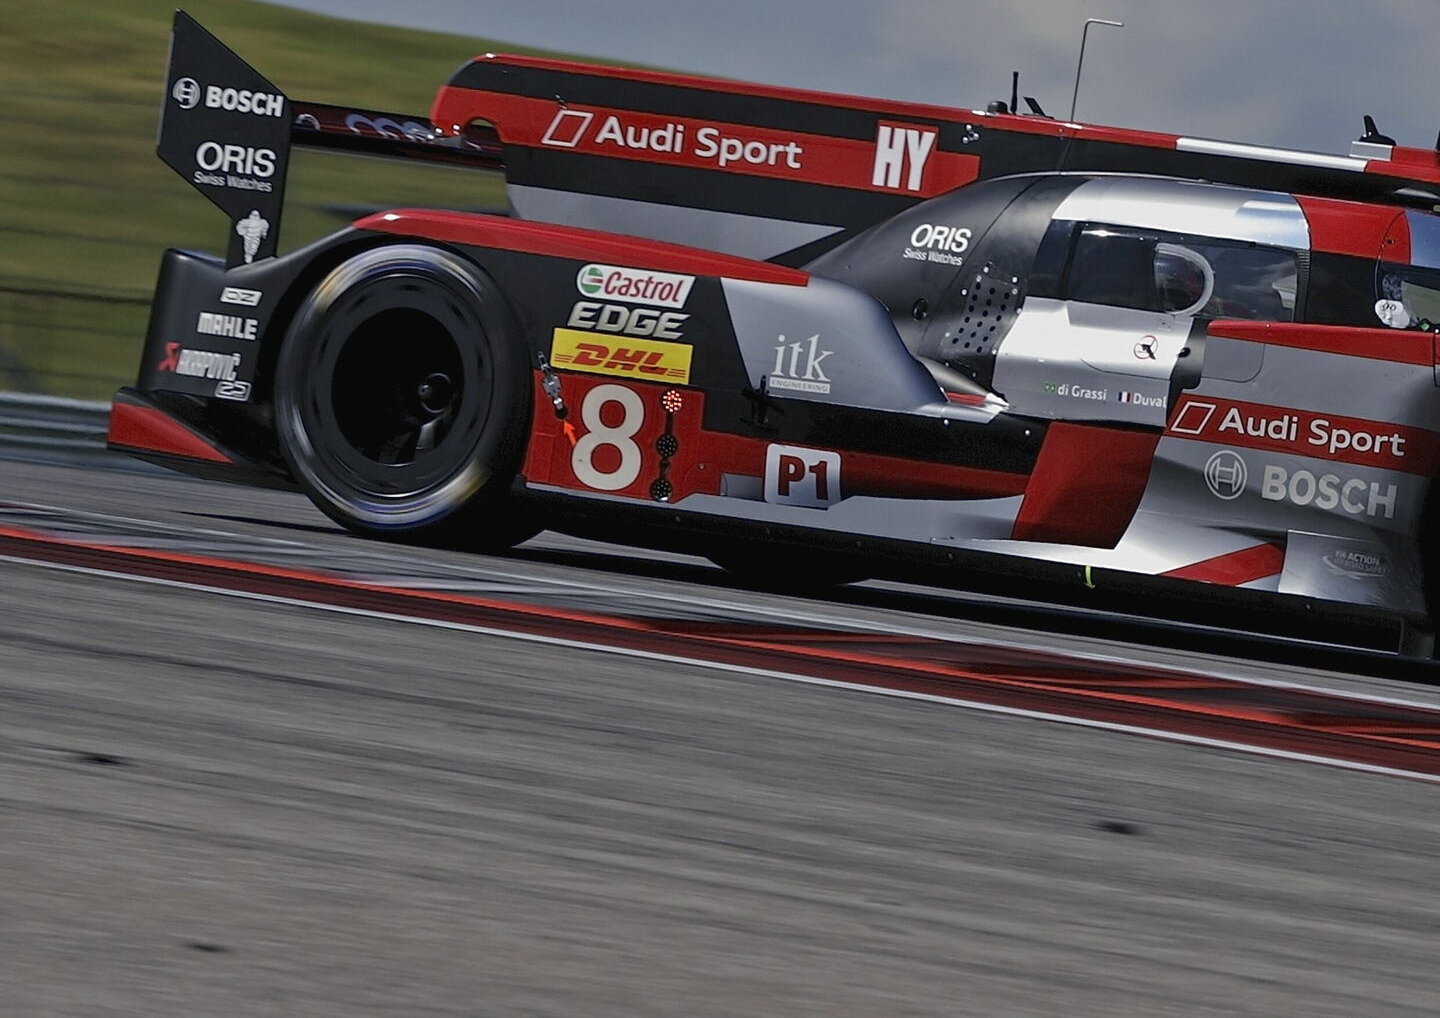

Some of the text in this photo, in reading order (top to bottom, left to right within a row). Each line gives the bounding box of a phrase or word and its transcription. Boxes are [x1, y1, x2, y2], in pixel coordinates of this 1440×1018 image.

[205, 85, 284, 117] BOSCH
[595, 115, 803, 168] Audi Sport
[196, 141, 276, 177] ORIS
[872, 125, 935, 192] HY
[193, 171, 272, 192] Swiss Watches
[910, 223, 972, 253] ORIS
[903, 247, 963, 267] Swiss Watches
[604, 270, 683, 303] Castrol
[197, 311, 258, 341] MAHLE
[567, 301, 691, 340] EDGE
[571, 343, 669, 375] DHL
[771, 333, 834, 382] itk
[771, 379, 829, 392] ENGINEERING
[1058, 383, 1107, 402] di Grassi
[1133, 392, 1167, 409] Duval
[571, 383, 645, 491] 8
[1218, 407, 1406, 457] Audi Sport
[778, 454, 828, 501] P1
[1261, 465, 1398, 519] BOSCH
[1347, 552, 1380, 566] ACTION
